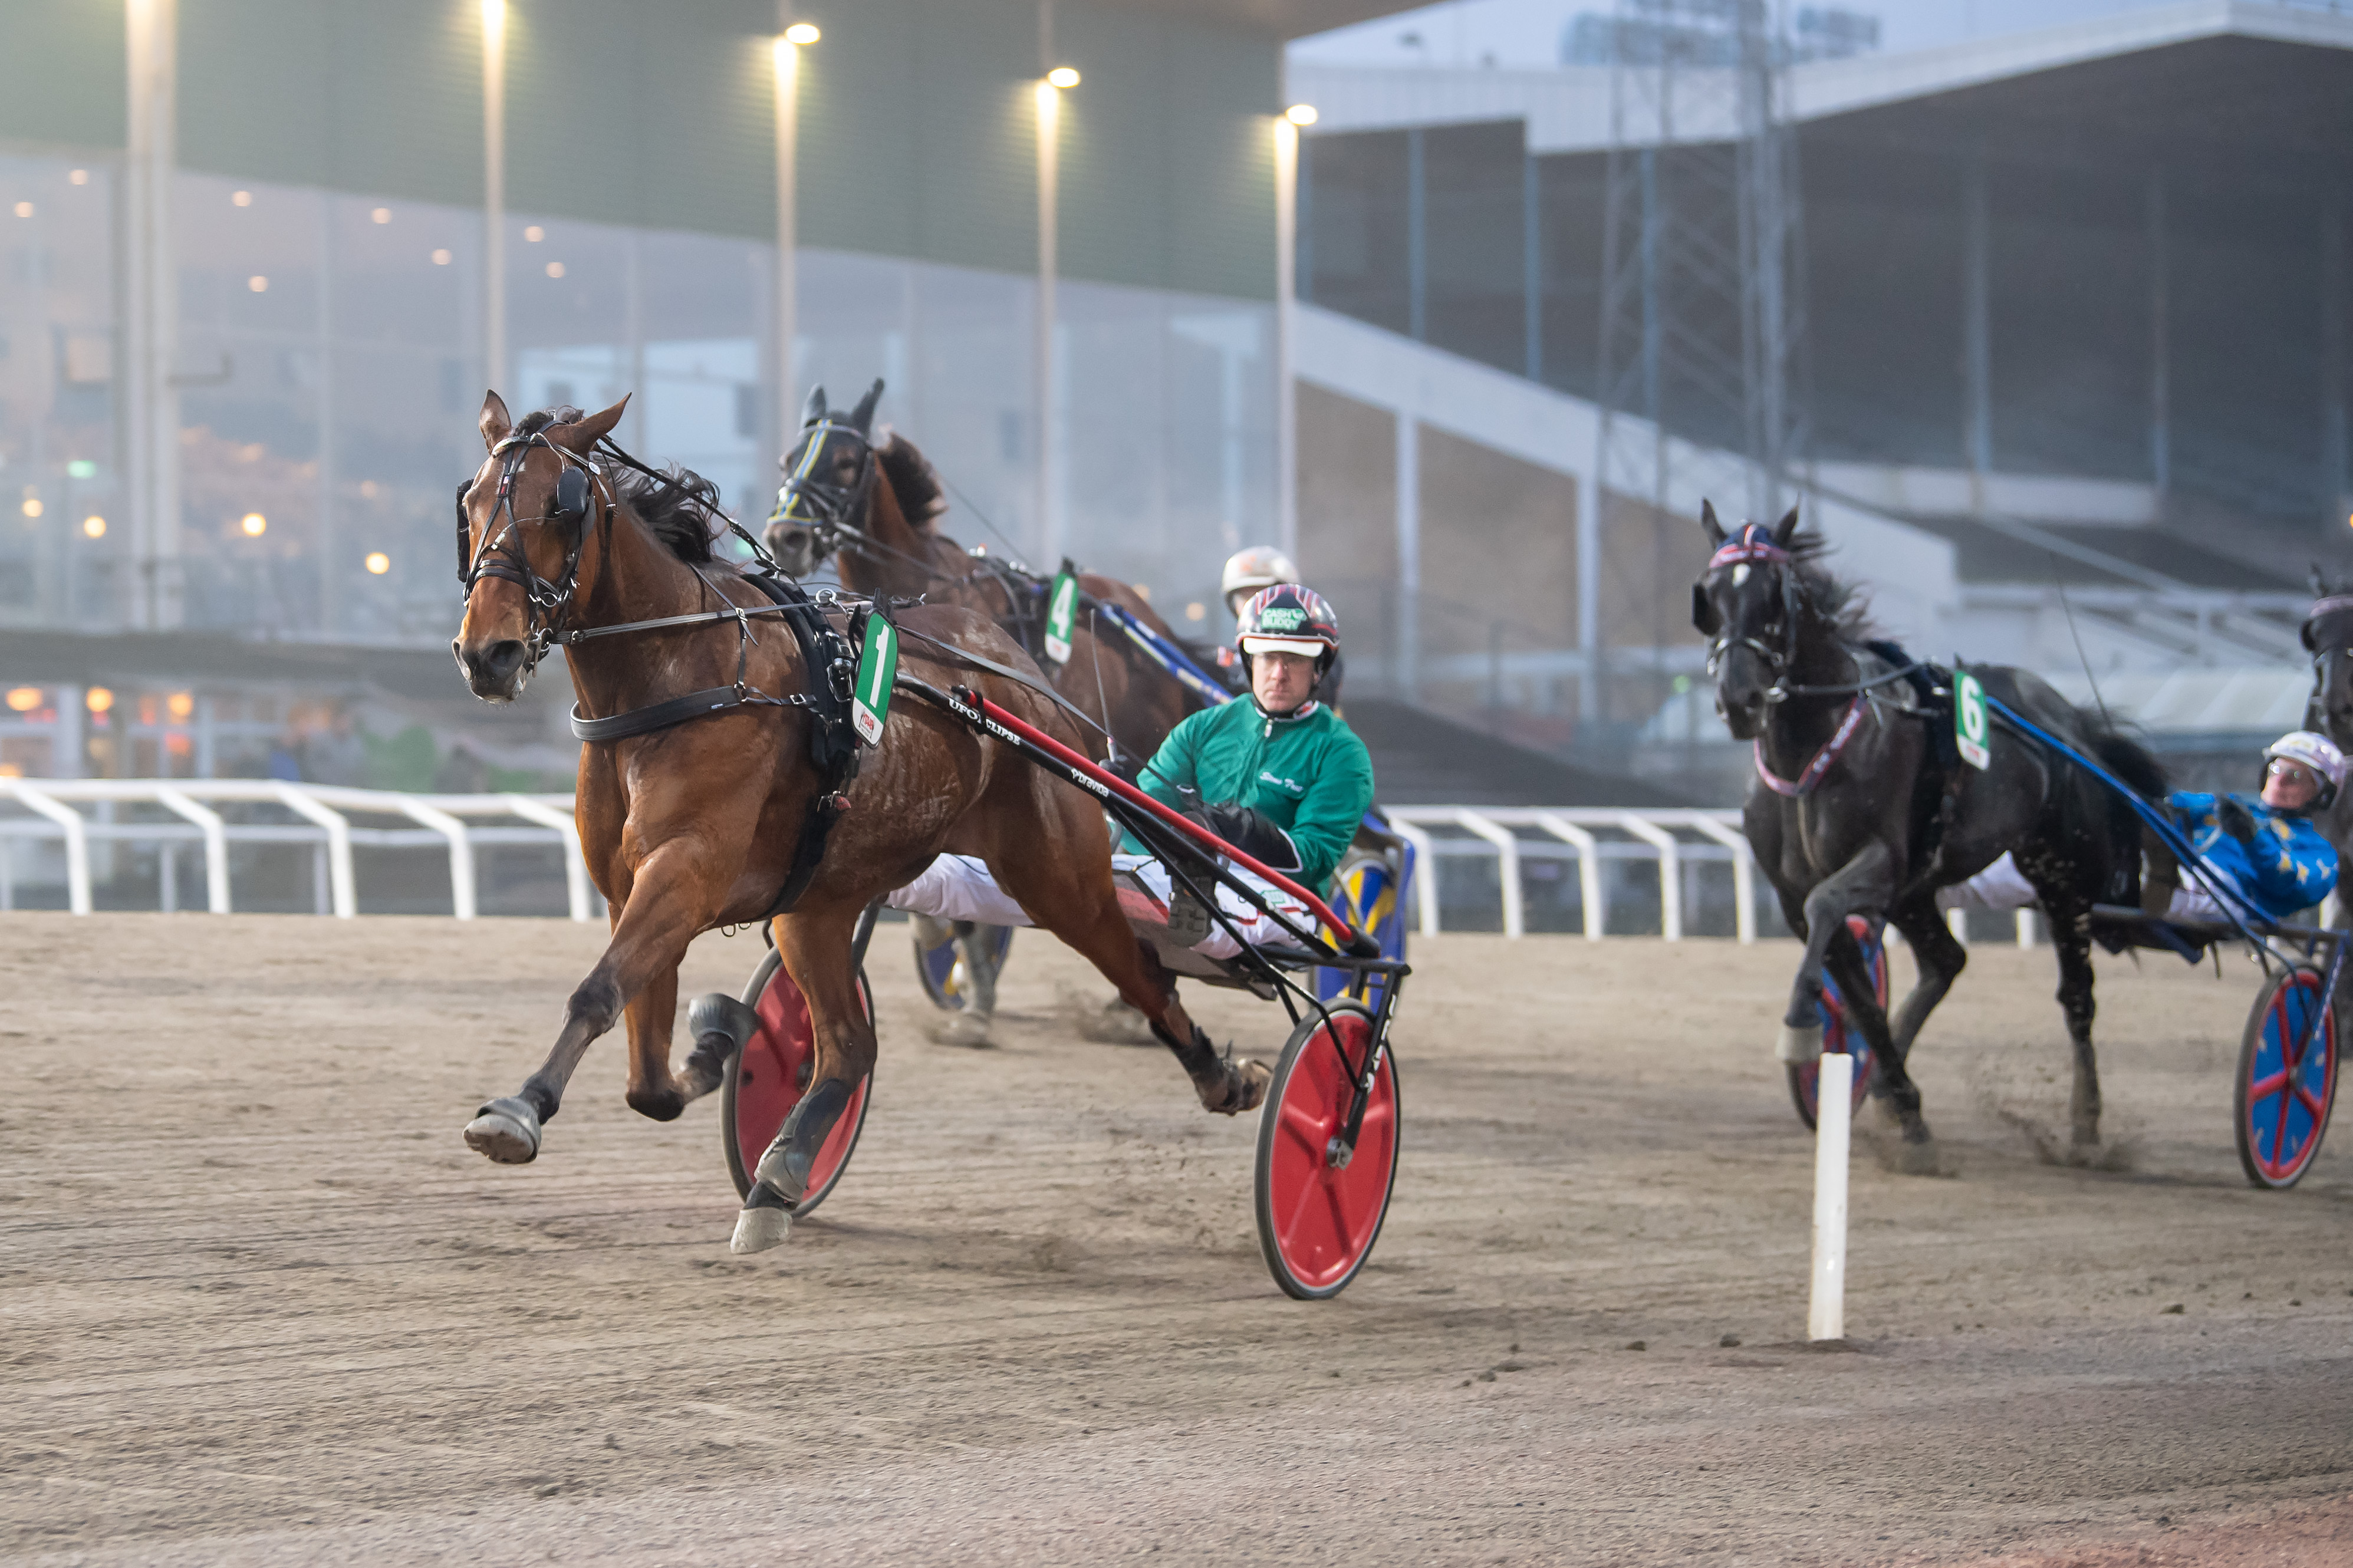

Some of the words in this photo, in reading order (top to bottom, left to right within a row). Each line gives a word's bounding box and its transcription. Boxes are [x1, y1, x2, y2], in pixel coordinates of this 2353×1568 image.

[1051, 578, 1075, 639] 4
[1263, 617, 1298, 629] BUDDY
[1264, 610, 1291, 618] CASH
[869, 624, 890, 709] 1
[948, 697, 979, 721] UFO
[978, 713, 1021, 746] CLIPSE
[1960, 676, 1984, 743] 6
